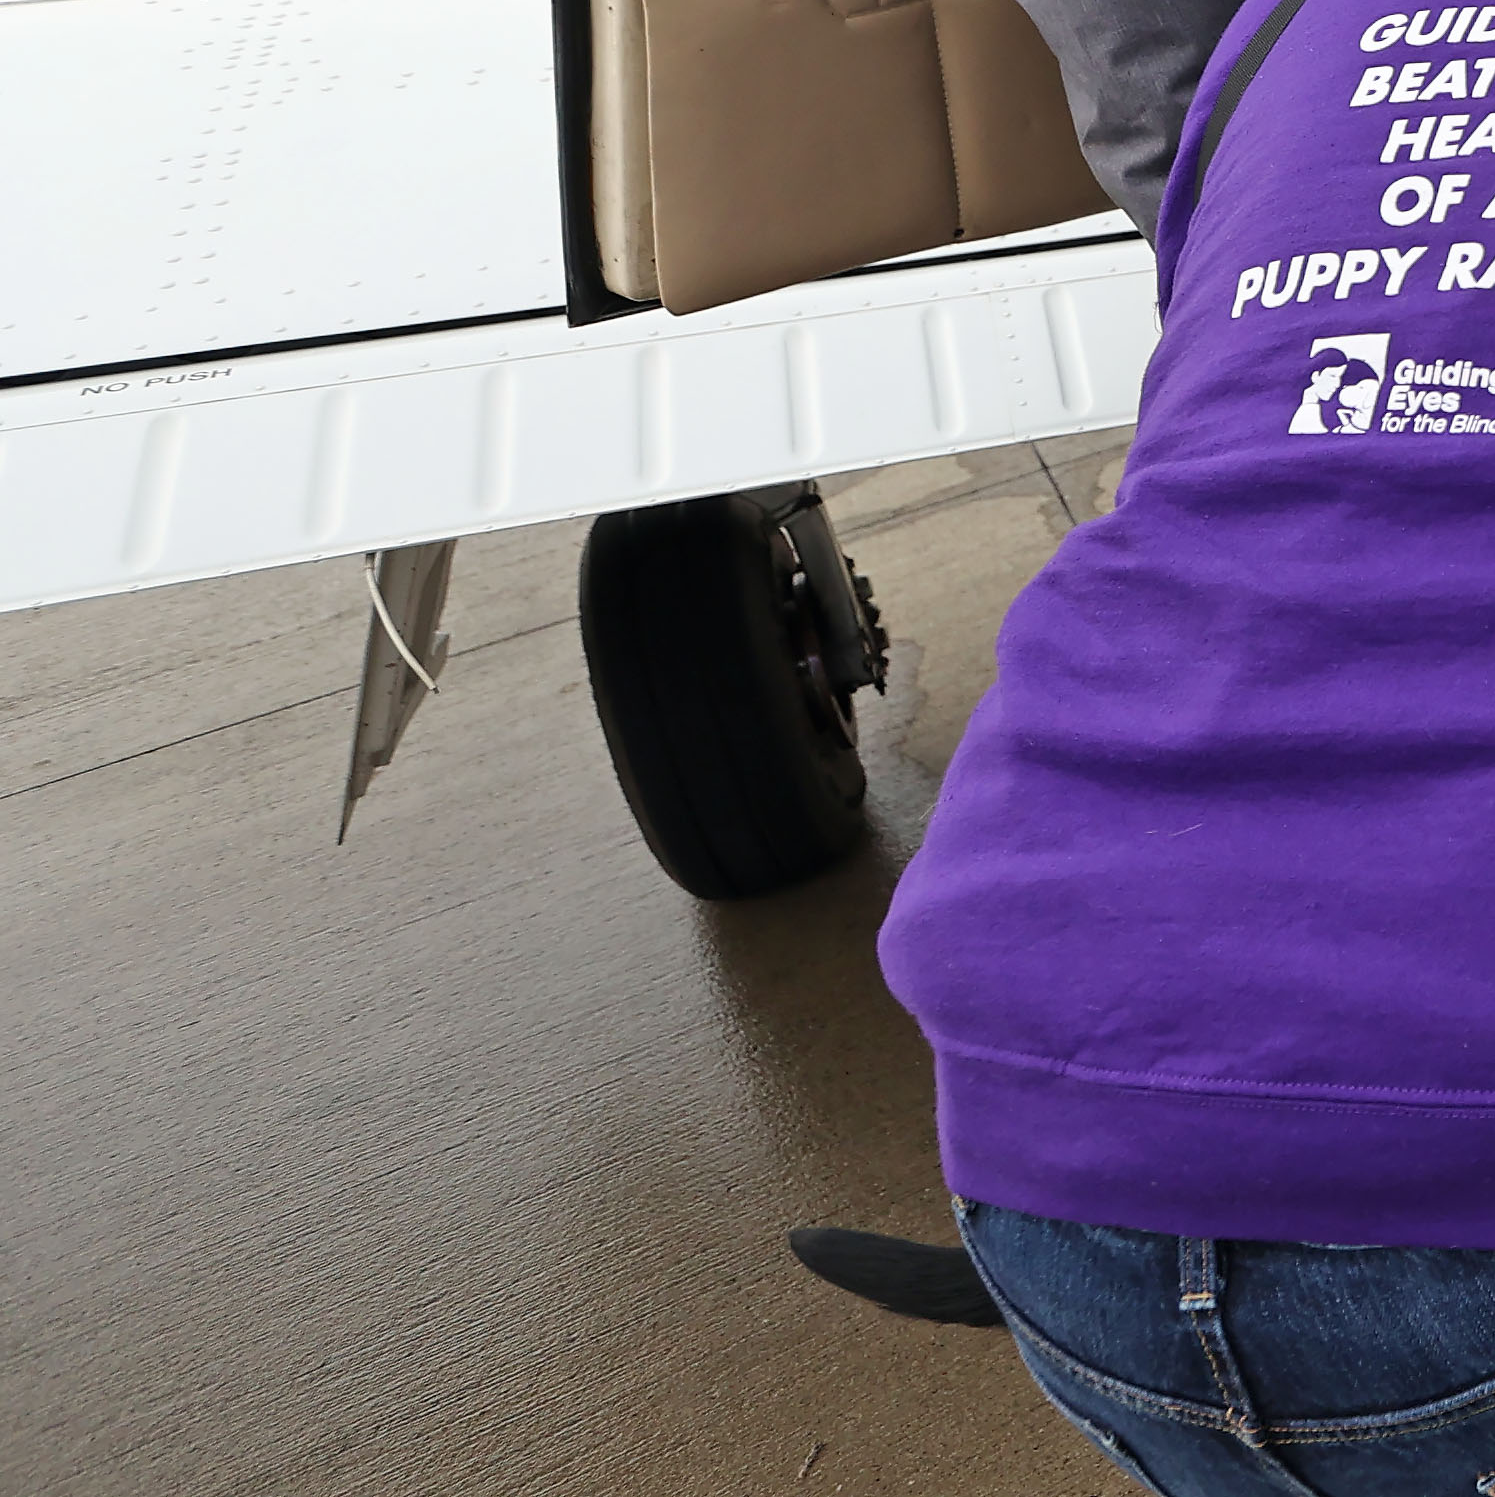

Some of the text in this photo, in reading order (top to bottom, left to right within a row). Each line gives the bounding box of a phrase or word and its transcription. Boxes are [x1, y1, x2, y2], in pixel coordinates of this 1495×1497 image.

[1379, 174, 1472, 227] OF
[1231, 246, 1429, 319] PUPPY
[80, 368, 232, 396] NO PUSH
[1386, 384, 1461, 416] Eyes
[1380, 412, 1411, 433] for
[1413, 413, 1448, 434] the
